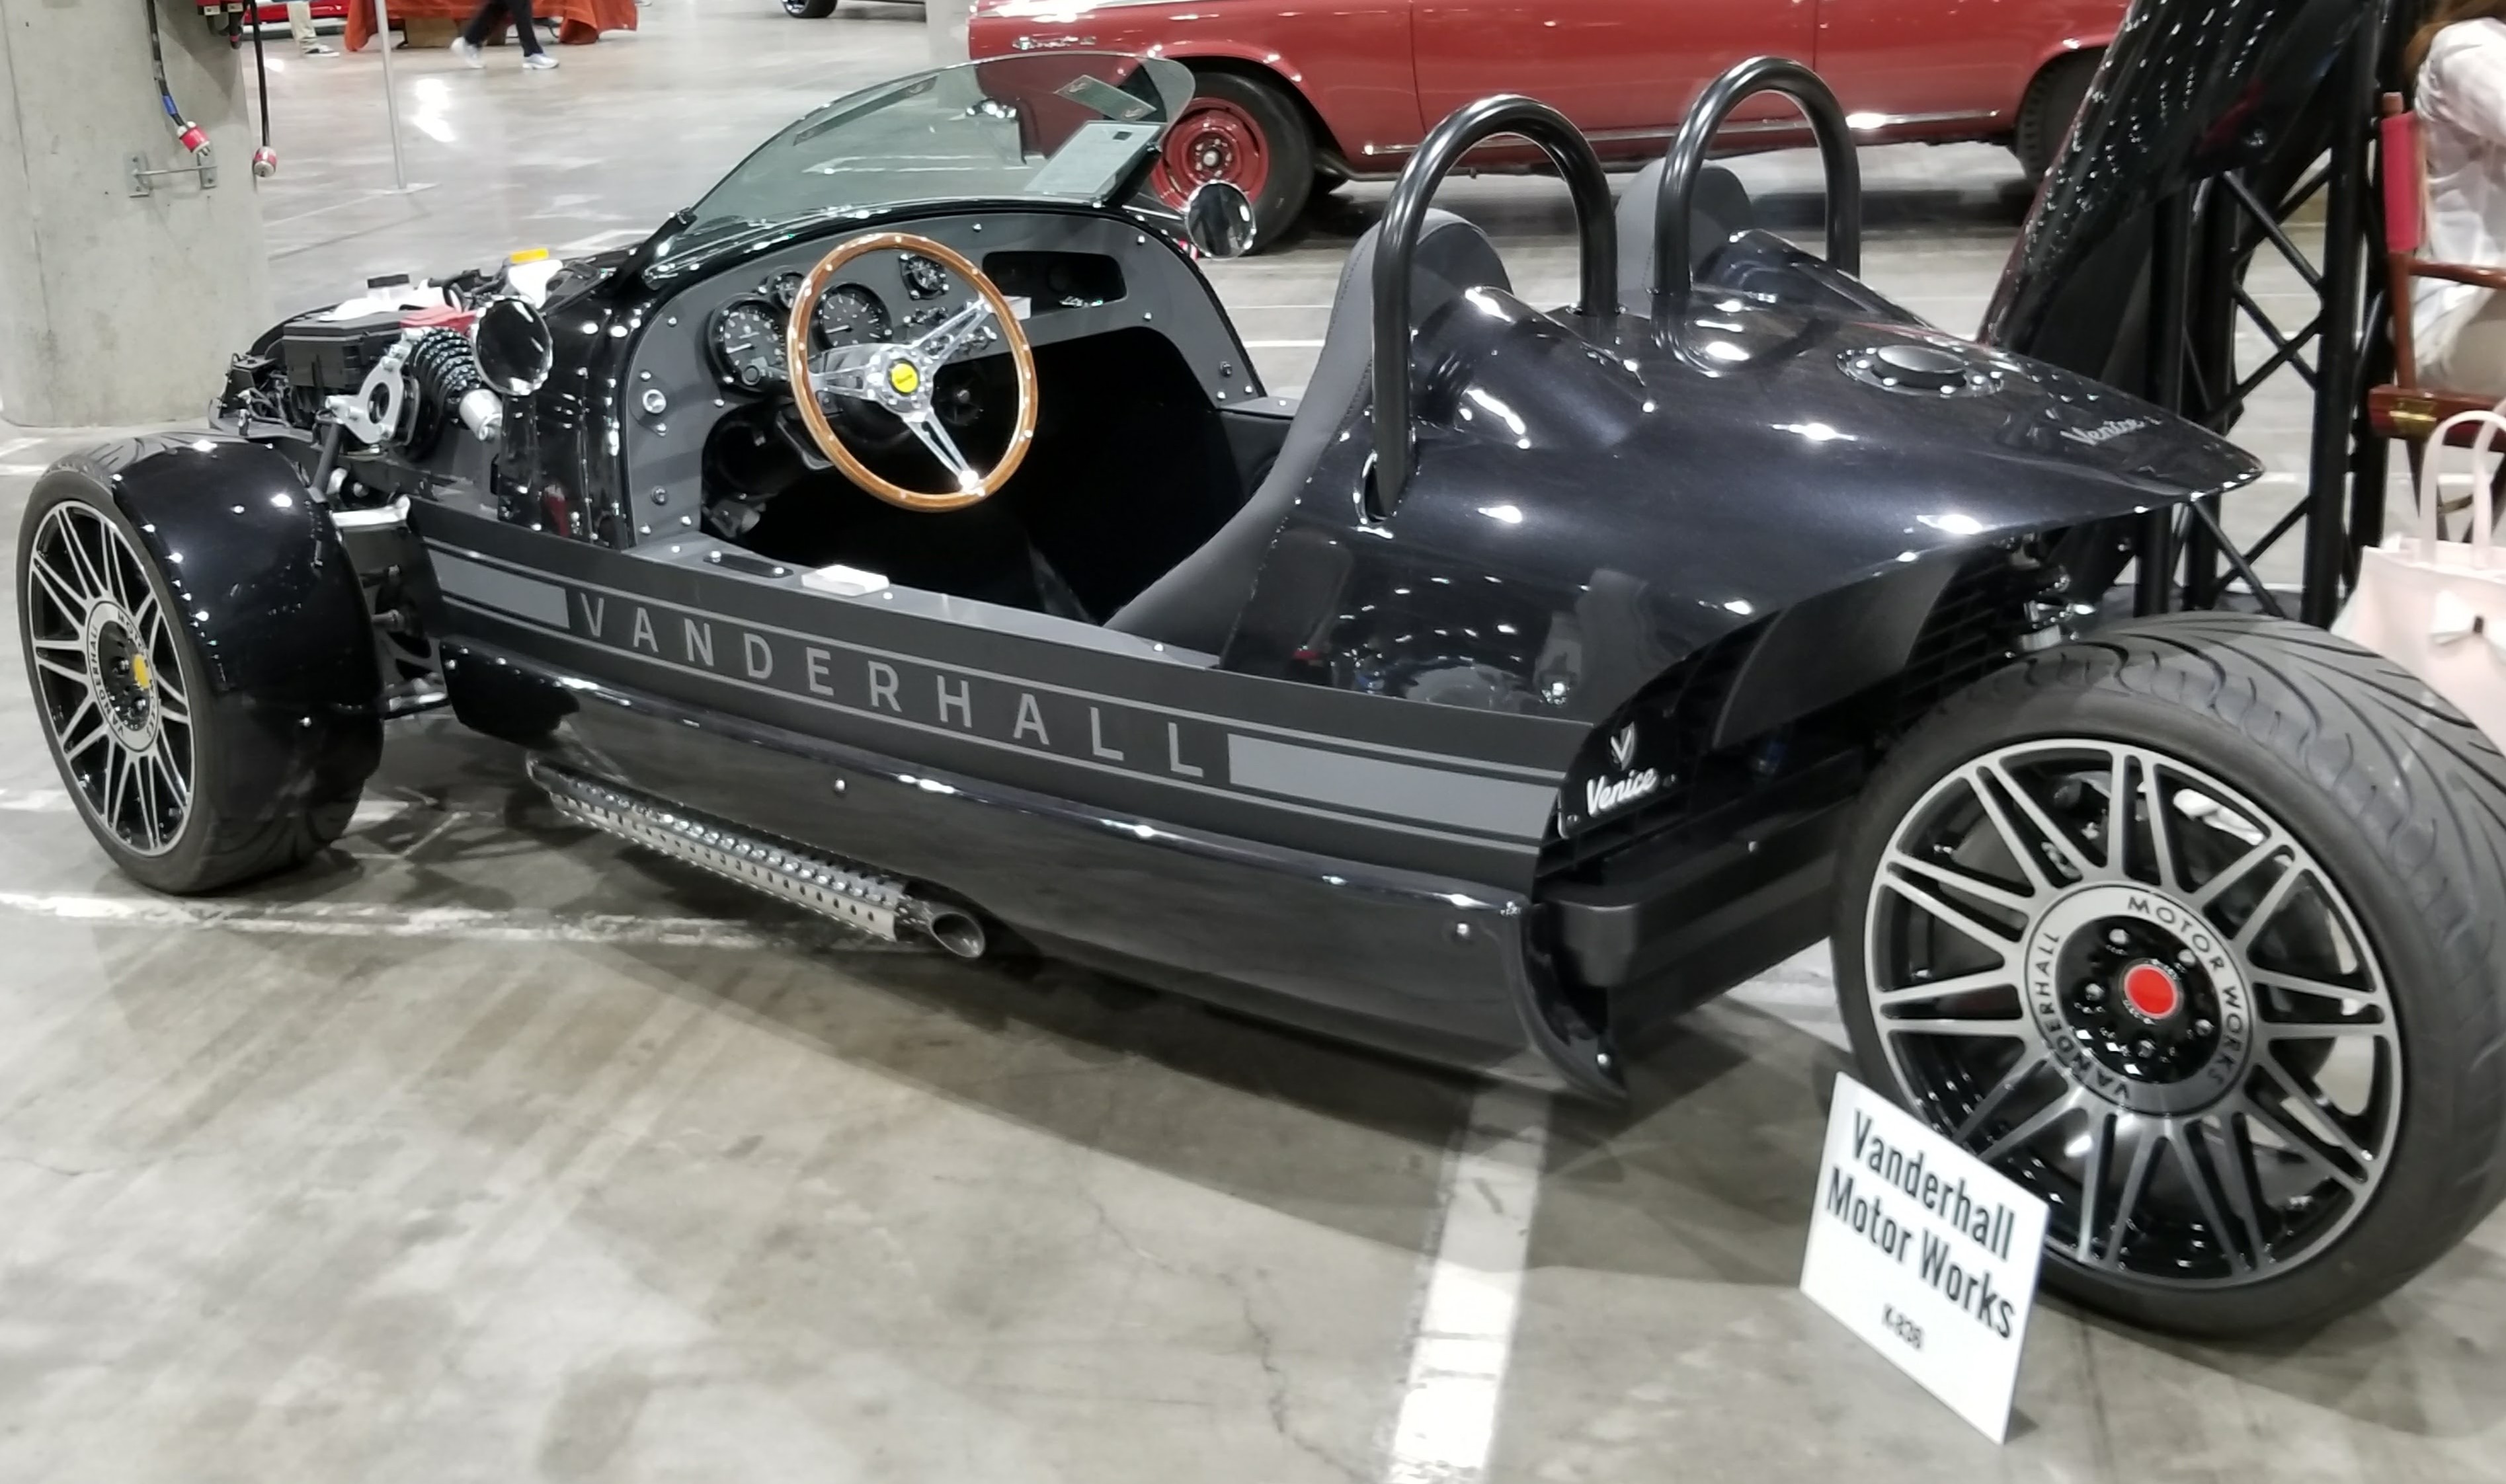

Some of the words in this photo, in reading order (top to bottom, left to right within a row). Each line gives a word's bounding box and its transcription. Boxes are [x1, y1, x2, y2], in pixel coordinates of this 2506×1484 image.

[581, 592, 1203, 777] VANDERHALL
[1587, 768, 1658, 816] Venice
[2034, 932, 2129, 1099] VANDERHALL
[2128, 896, 2224, 970] MOTOR
[2206, 986, 2243, 1085] WORKS
[1827, 1167, 1912, 1262] Motor
[1919, 1228, 2016, 1339] Works
[1854, 1111, 2015, 1261] Vanderhall
